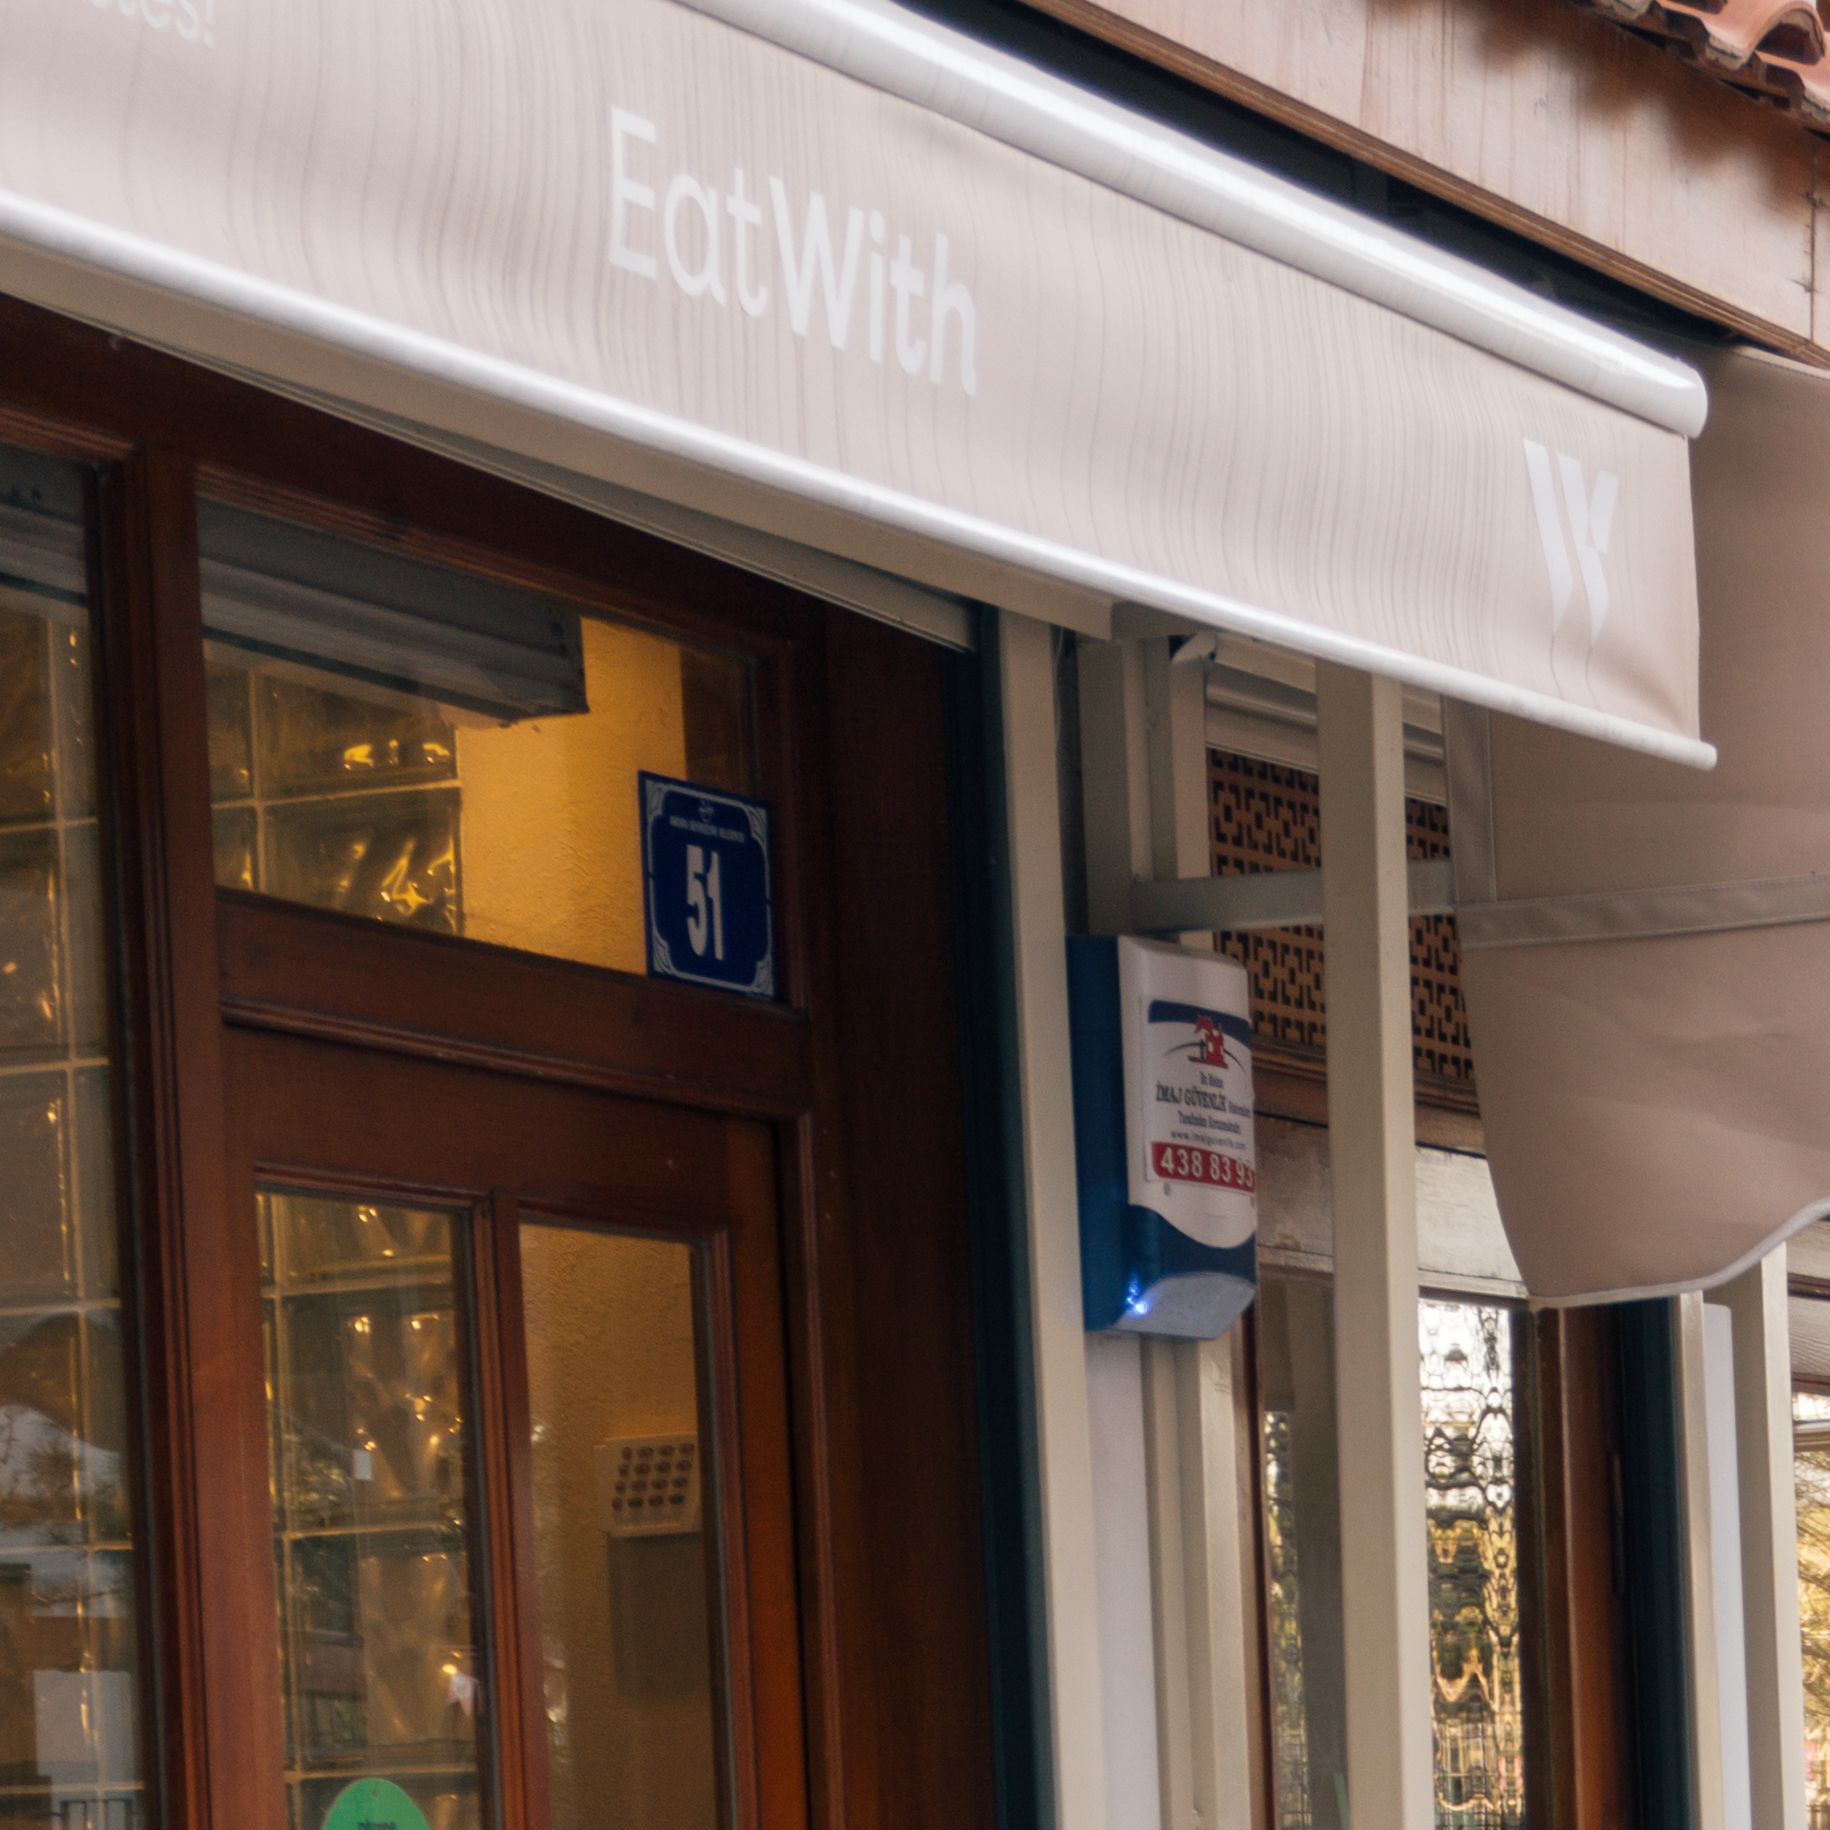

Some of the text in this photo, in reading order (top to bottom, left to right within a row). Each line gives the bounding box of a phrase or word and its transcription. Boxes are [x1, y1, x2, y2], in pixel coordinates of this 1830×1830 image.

[607, 106, 979, 397] EatWith
[686, 843, 724, 961] 51
[1160, 1147, 1204, 1178] 438
[1209, 1154, 1232, 1183] 83
